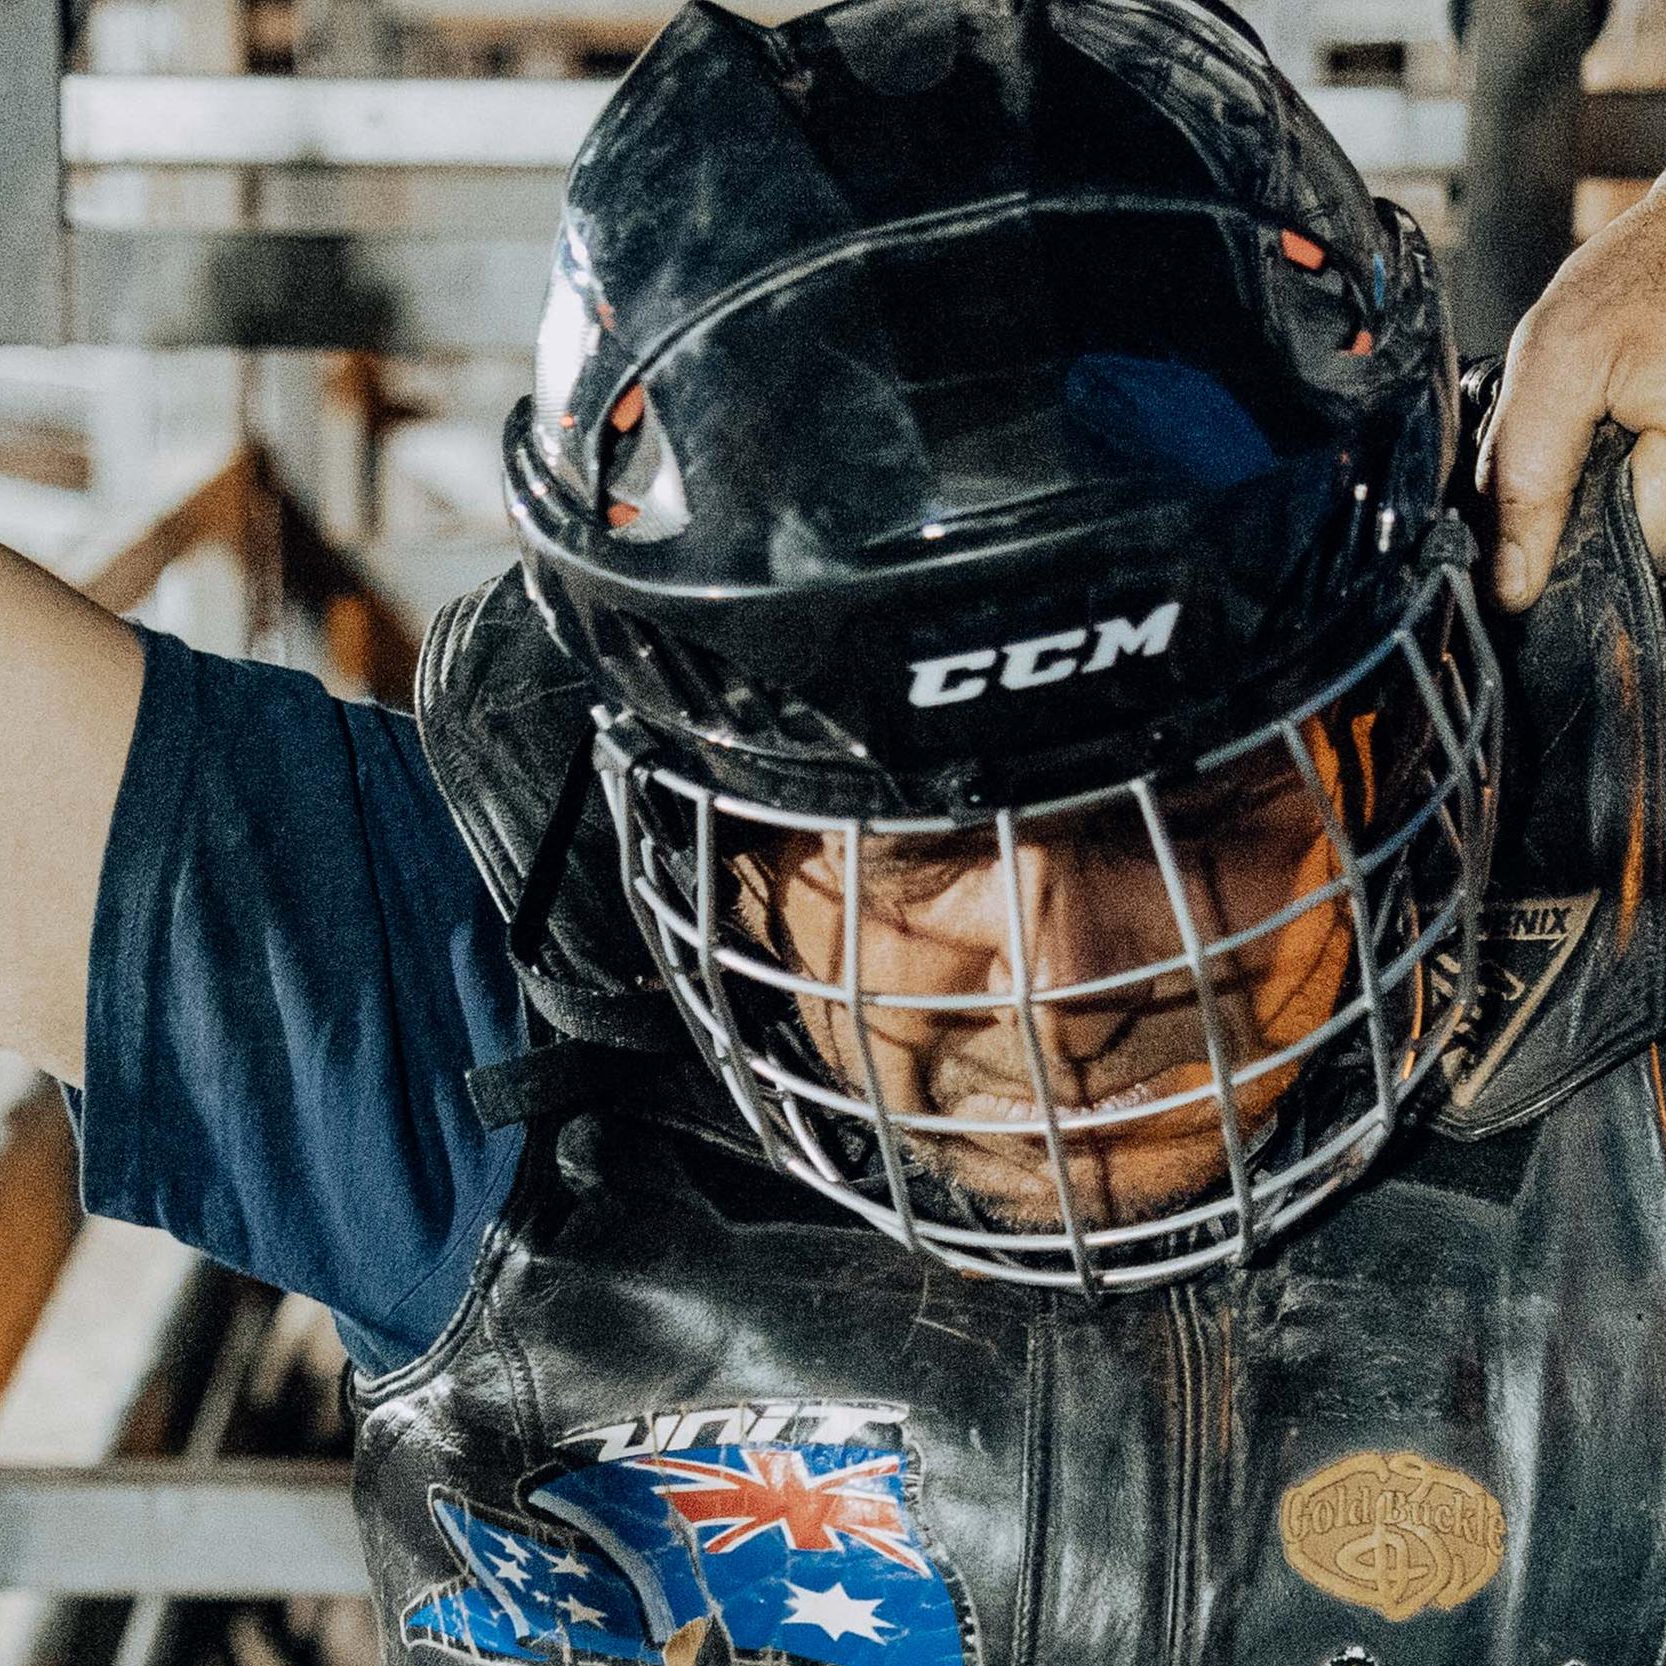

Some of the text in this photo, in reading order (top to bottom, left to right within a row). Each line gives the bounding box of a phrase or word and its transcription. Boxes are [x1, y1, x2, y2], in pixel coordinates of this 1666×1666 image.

[908, 602, 1181, 708] CCM
[554, 1403, 910, 1463] UNIT
[1288, 1483, 1507, 1556] Gold Buckle
